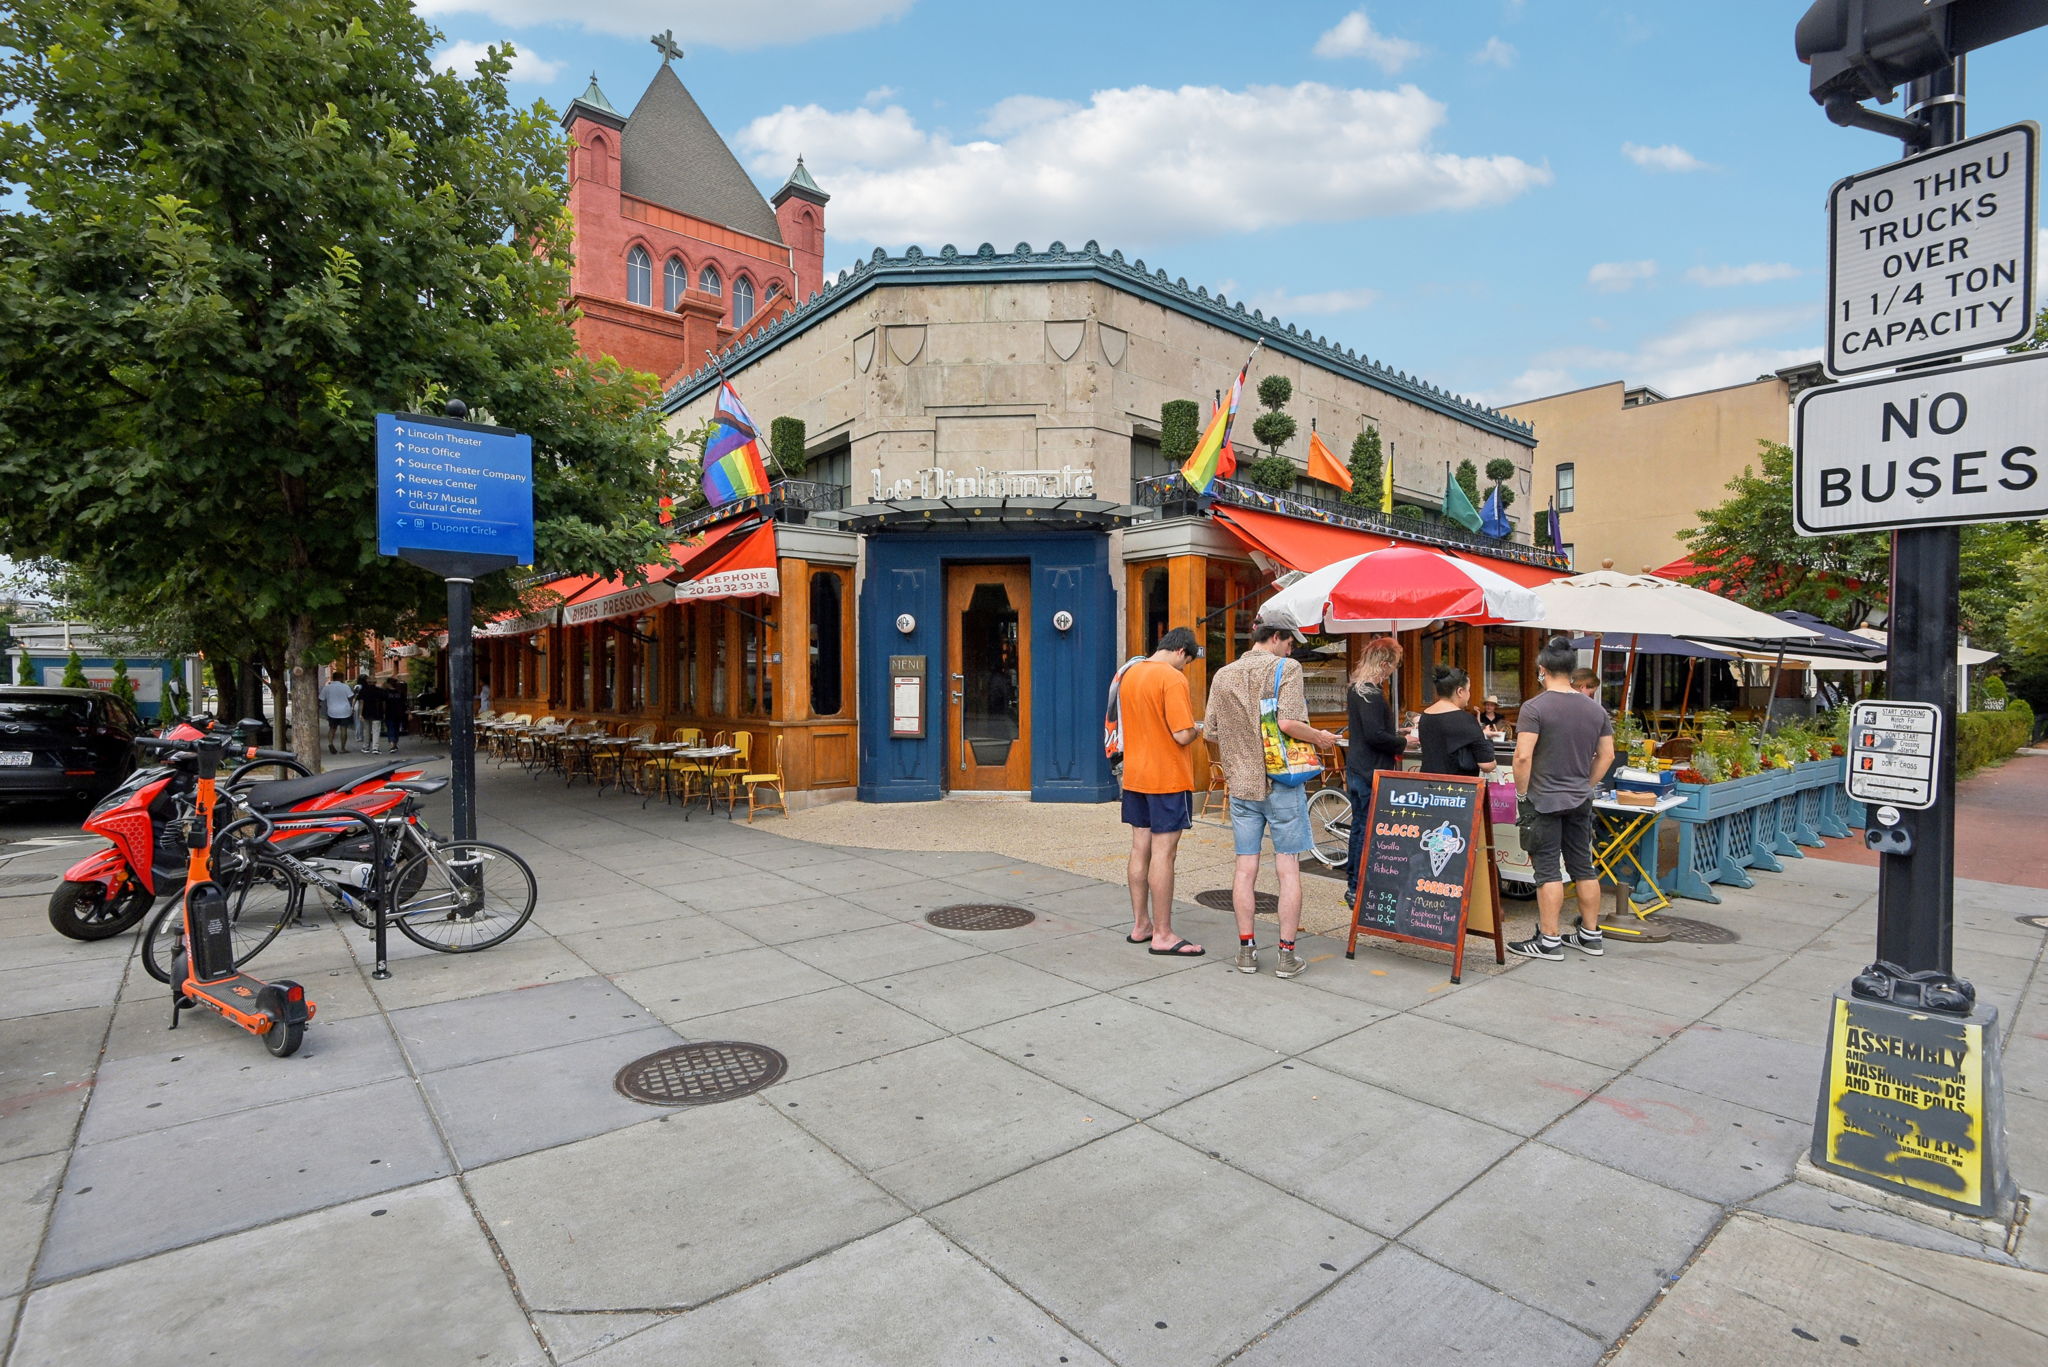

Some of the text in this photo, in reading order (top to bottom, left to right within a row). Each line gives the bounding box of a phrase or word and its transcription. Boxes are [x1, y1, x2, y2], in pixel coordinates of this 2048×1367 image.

[1850, 151, 2010, 221] NO THRU
[1859, 192, 1997, 251] TRUCKS
[1883, 237, 1969, 278] OVER
[1842, 259, 2016, 322] 1 1/4 TON
[1842, 296, 2014, 355] CAPACITY
[1882, 391, 1968, 443] NO
[408, 429, 482, 447] Lincoln Theater
[408, 444, 461, 459] Post Office
[408, 459, 527, 483] Source Theater Company
[1820, 445, 2038, 508] BUSES
[408, 474, 478, 490] Reeves Center
[871, 465, 1093, 500] Le Diplomate
[408, 489, 478, 505] HR-57 Musical
[408, 501, 482, 515] Cultural Center
[431, 522, 468, 534] Dupont
[471, 525, 497, 536] Circle
[697, 572, 767, 585] ELEPHONE
[689, 581, 769, 595] 20 23 32 33 33
[572, 590, 656, 622] BIERES PRESSION
[1882, 708, 1925, 718] START CROSSING
[1900, 761, 1918, 770] CROSS
[1390, 790, 1467, 808] Le Diplomate
[1375, 822, 1420, 838] GLACES
[1376, 841, 1400, 850] Vanilla
[1415, 878, 1464, 898] SORBETS
[1414, 896, 1445, 911] Mango
[1410, 918, 1443, 935] Strawberry
[1846, 1027, 1967, 1073] ASSEMBLY
[1845, 1076, 1870, 1092] AND
[1875, 1082, 1890, 1097] TO
[1895, 1087, 1918, 1105] THE
[1945, 1083, 1966, 1101] DC
[1915, 1135, 1929, 1149] 10
[1935, 1139, 1964, 1159] A.M.
